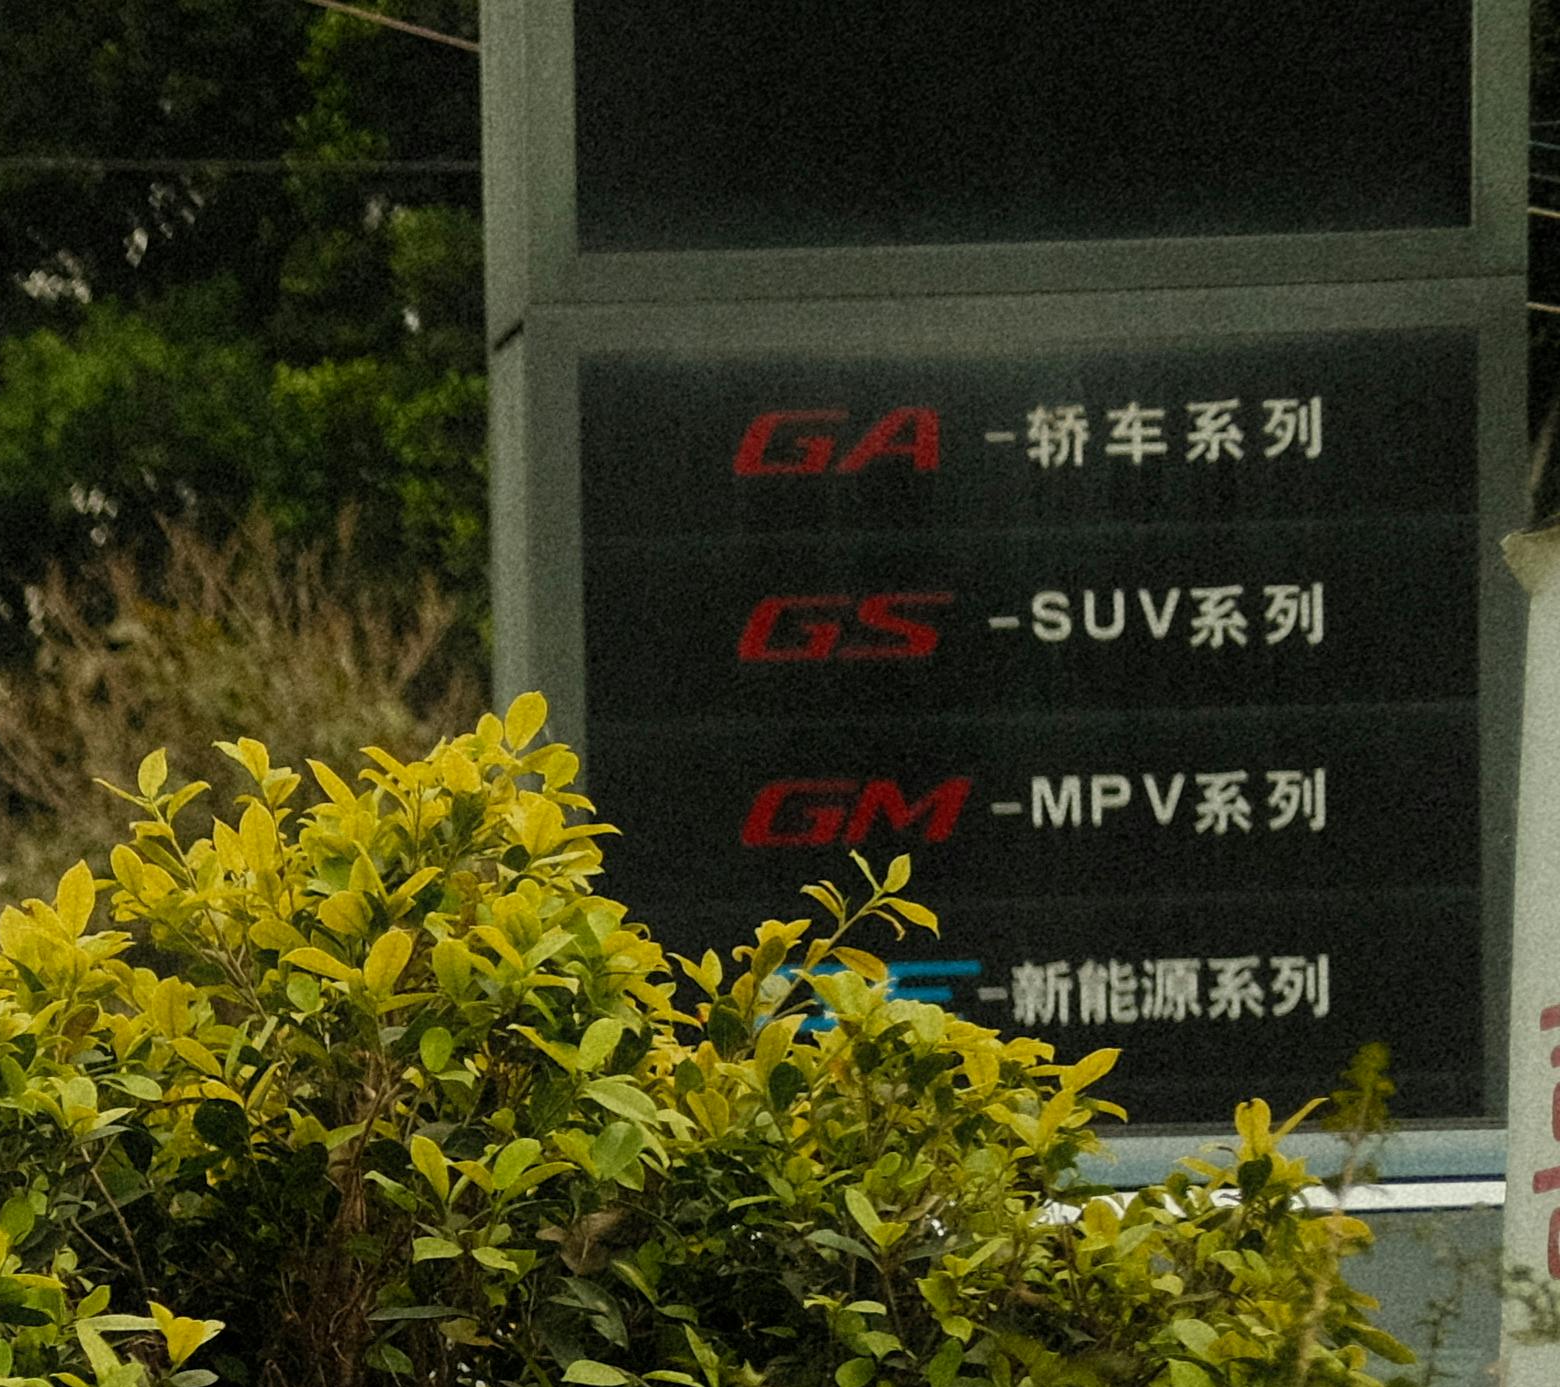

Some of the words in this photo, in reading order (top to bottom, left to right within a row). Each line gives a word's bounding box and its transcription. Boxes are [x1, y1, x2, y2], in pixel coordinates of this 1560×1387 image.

[732, 405, 940, 476] GA
[737, 592, 954, 662] GS
[740, 776, 972, 847] GM
